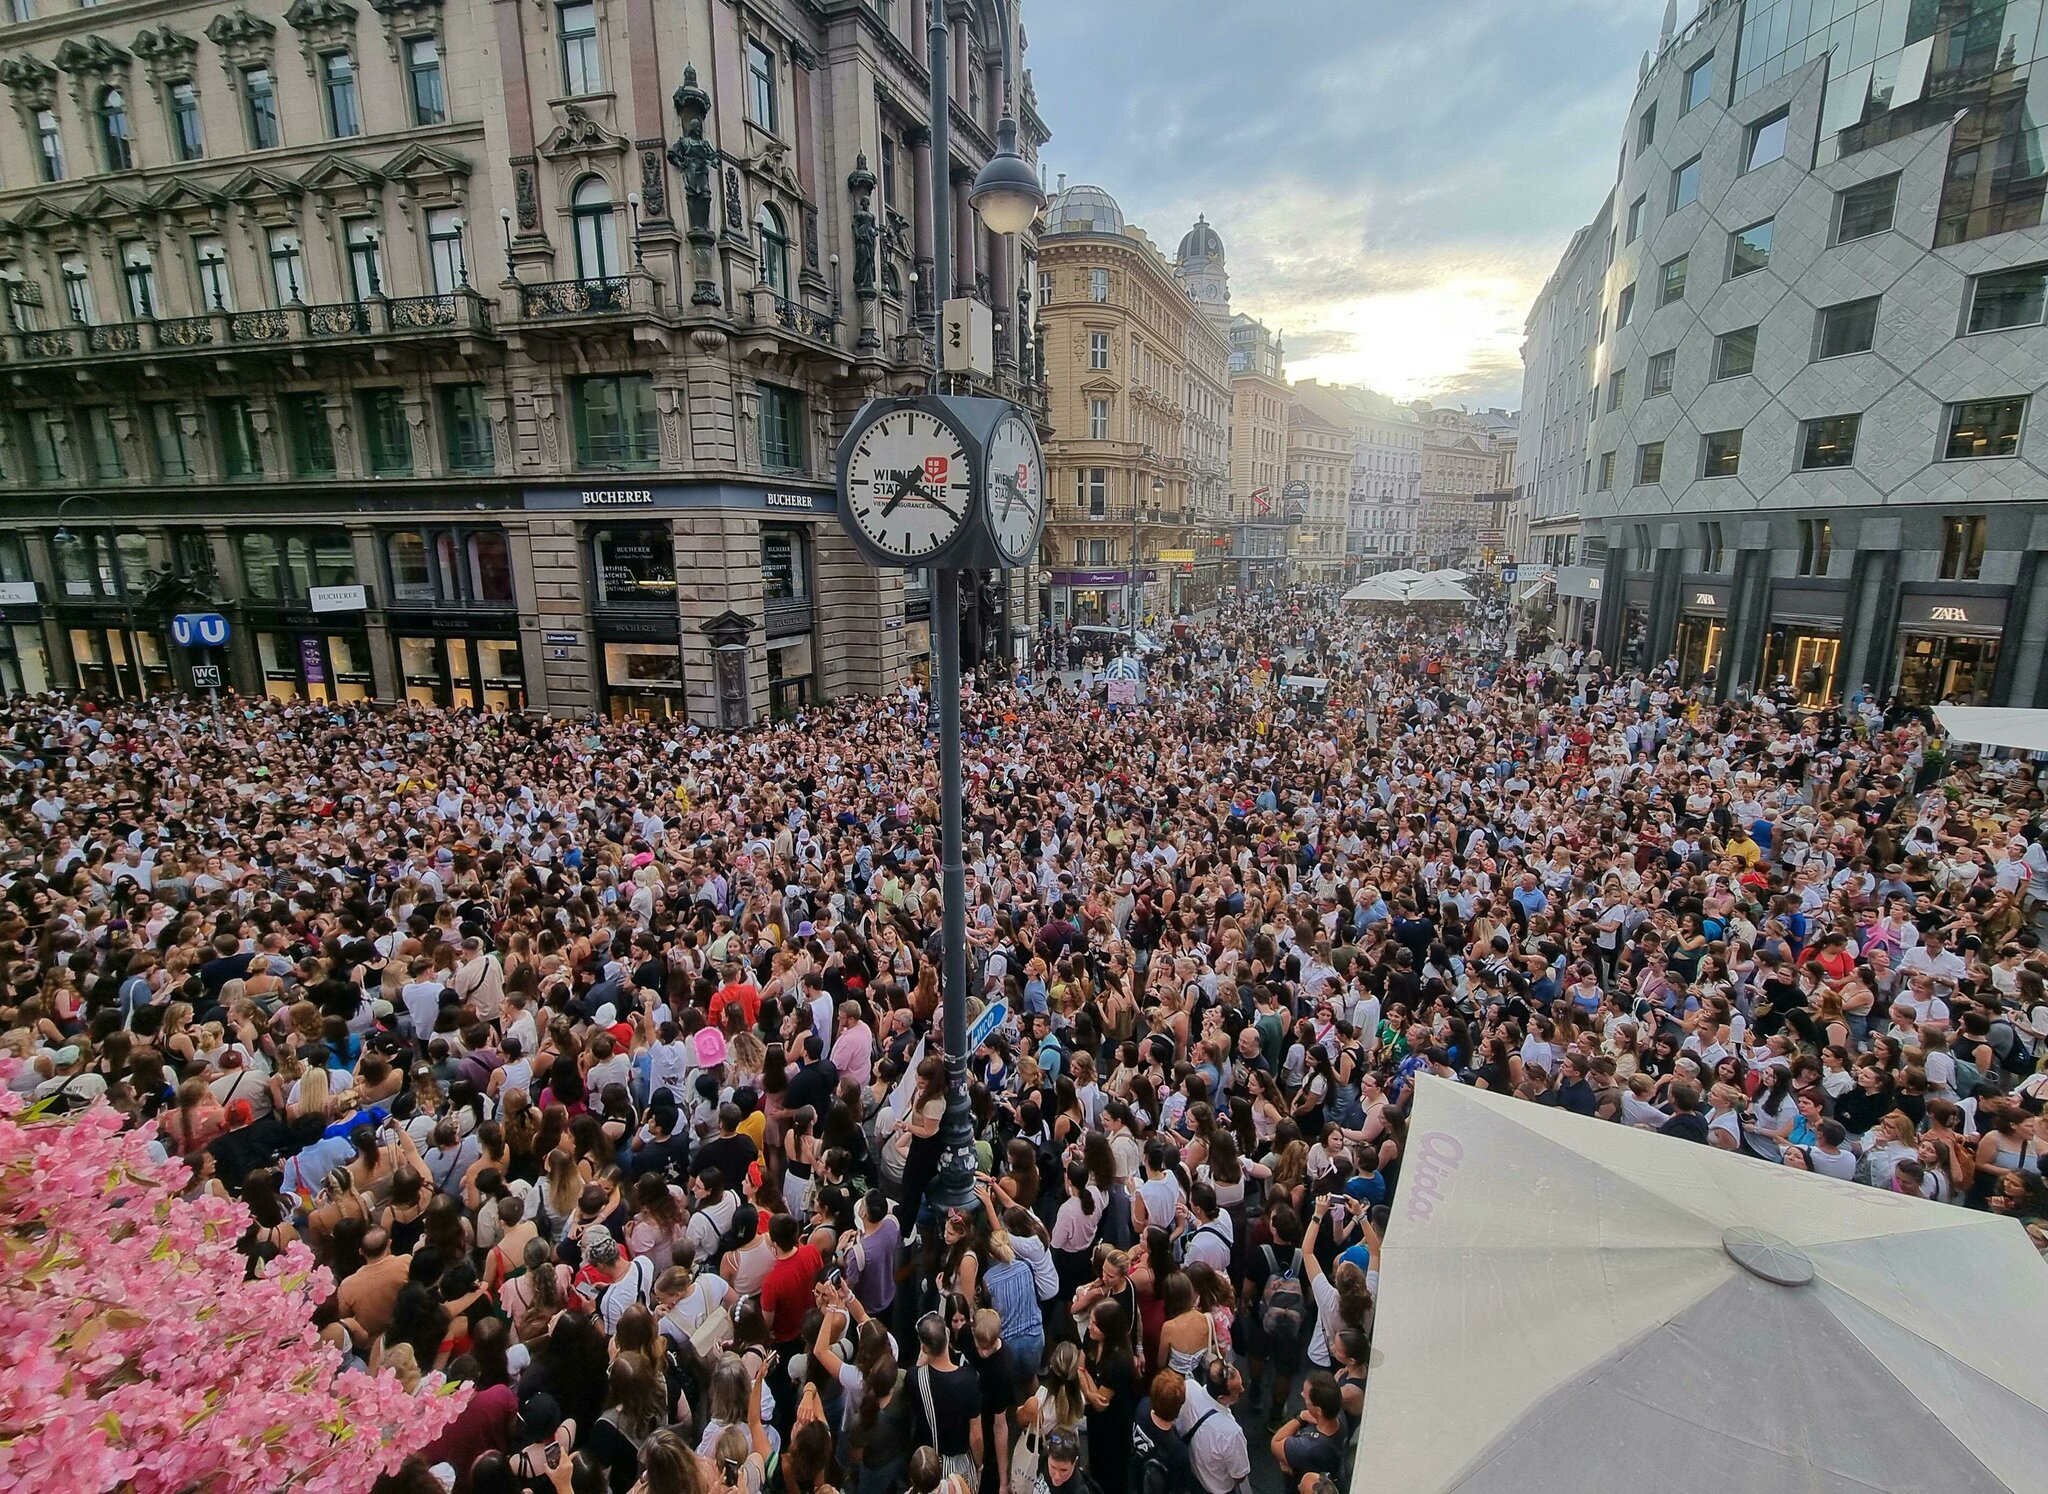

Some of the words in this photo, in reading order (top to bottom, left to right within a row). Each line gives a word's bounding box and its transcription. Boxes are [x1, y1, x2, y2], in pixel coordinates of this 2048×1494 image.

[581, 490, 653, 504] BUCHERER
[767, 493, 813, 508] BUCHERER
[1504, 572, 1516, 582] U
[318, 592, 359, 600] BUCHERER
[1696, 593, 1716, 605] ZARA
[1931, 606, 1969, 621] ZARA
[173, 621, 190, 643] U
[200, 620, 225, 643] U
[195, 668, 217, 678] WC
